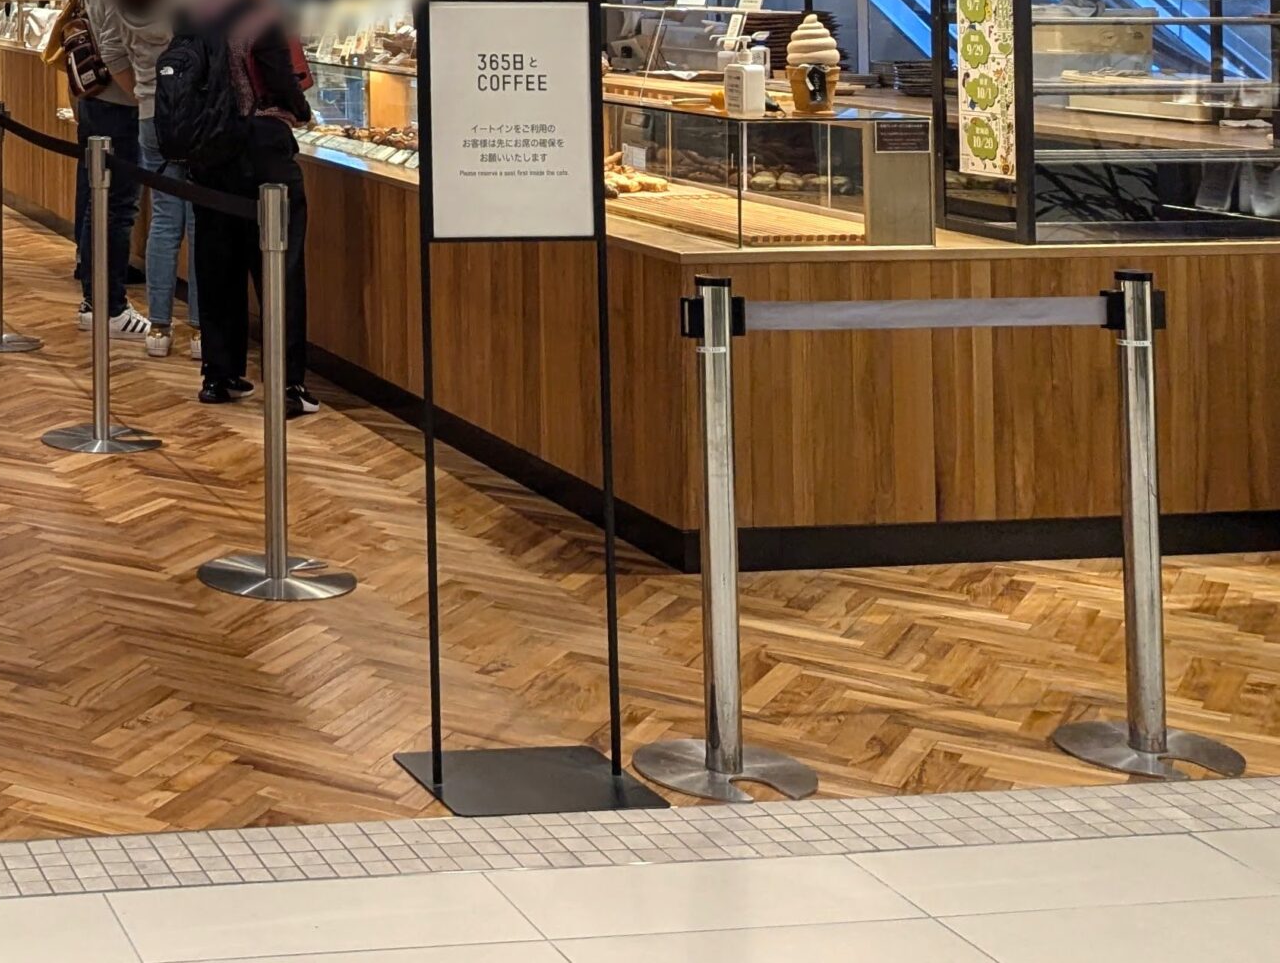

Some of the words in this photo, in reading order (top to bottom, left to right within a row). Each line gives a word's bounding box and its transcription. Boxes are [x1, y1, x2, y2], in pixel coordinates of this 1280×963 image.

[966, 0, 980, 11] 9/7
[966, 43, 984, 56] 9/29
[477, 74, 548, 92] COFFEE
[976, 87, 992, 99] 10/1
[471, 124, 556, 134] イートインをご利用の
[462, 138, 565, 149] お客様は先にお席の確保を
[972, 135, 994, 149] 10/20
[479, 153, 548, 163] お願いいたします
